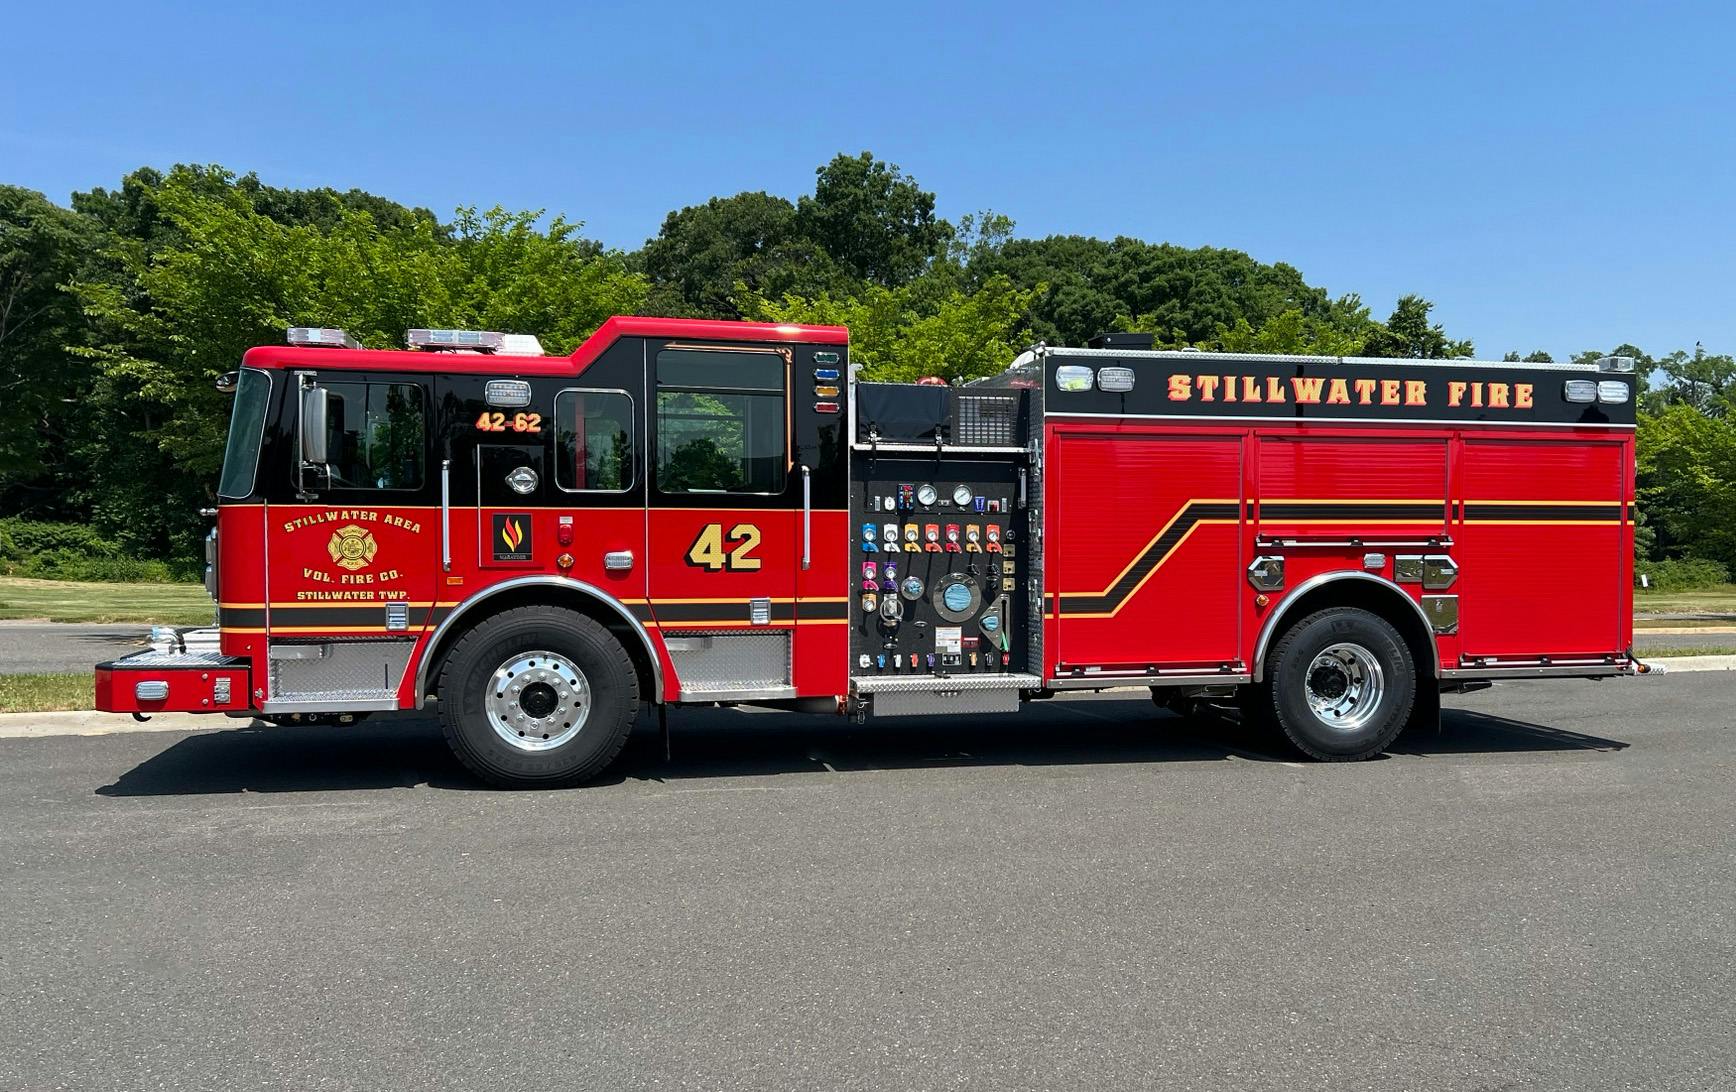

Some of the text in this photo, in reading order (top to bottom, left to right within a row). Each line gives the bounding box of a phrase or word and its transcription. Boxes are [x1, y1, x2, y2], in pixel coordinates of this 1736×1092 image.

[1167, 374, 1534, 408] STILLWATER FIRE
[475, 412, 542, 432] 42-62
[284, 510, 422, 534] STILLWATER AREA
[684, 523, 762, 573] 42
[303, 568, 404, 584] VOL. FIRE CO.
[297, 591, 411, 600] STILLWATER TWP.
